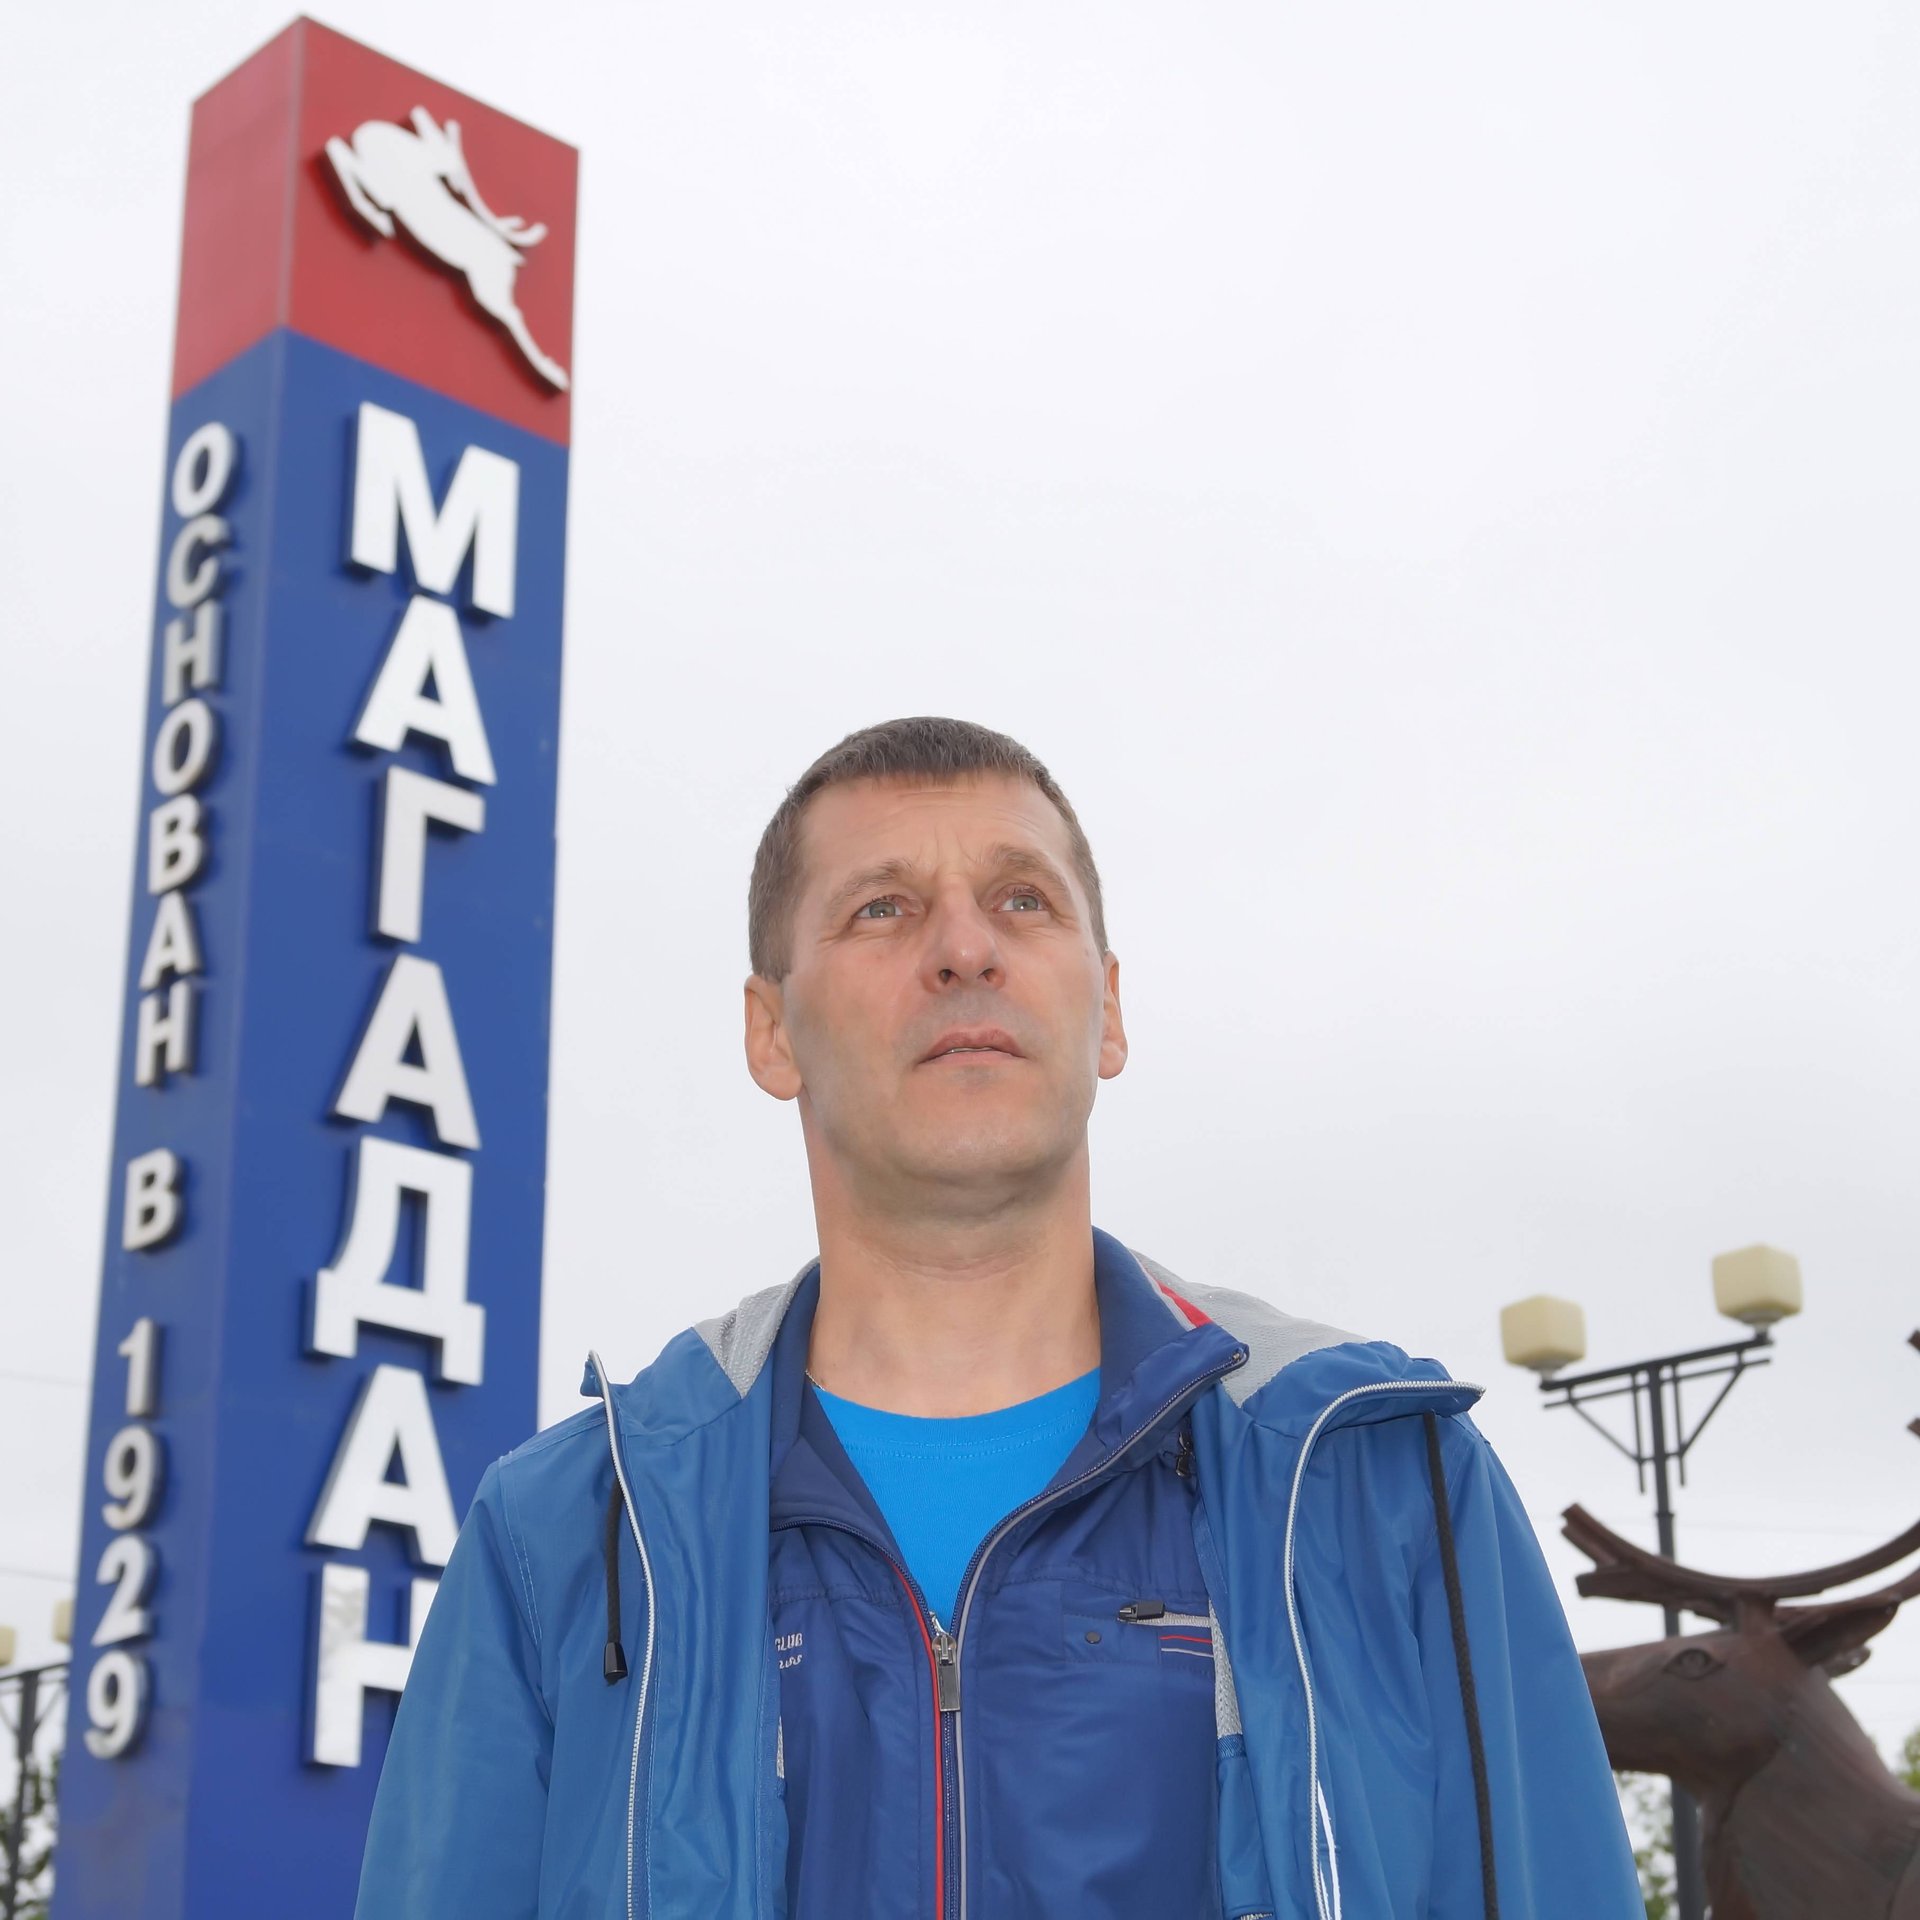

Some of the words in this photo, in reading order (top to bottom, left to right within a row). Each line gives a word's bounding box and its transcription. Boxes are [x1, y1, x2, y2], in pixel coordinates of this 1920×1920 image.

[135, 421, 236, 1087] ОСНОВАН
[123, 1148, 182, 1252] В
[308, 401, 520, 1767] МАГАДАН
[84, 1318, 161, 1759] 1929
